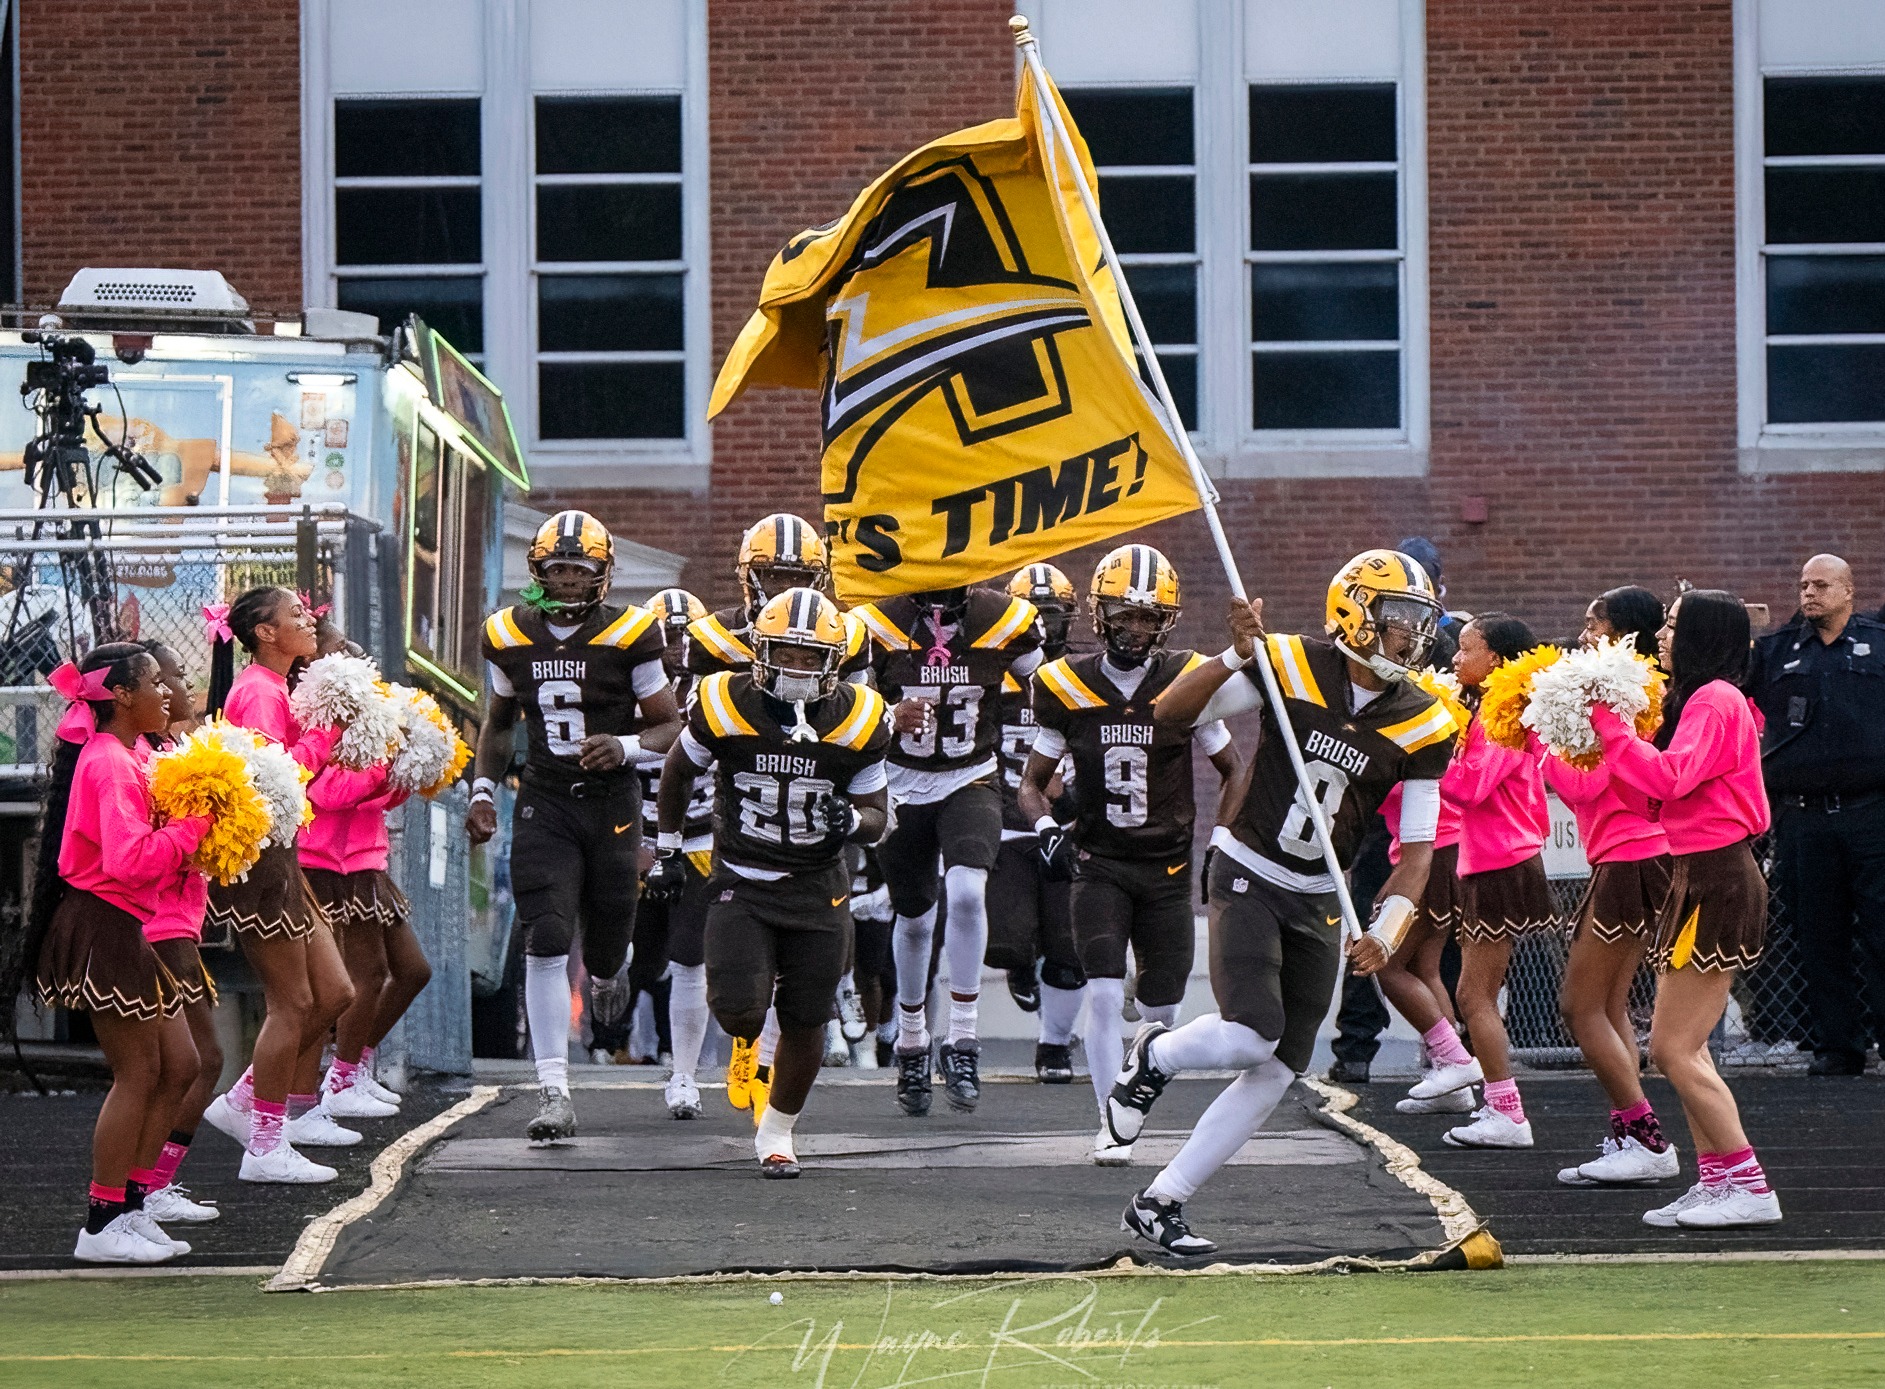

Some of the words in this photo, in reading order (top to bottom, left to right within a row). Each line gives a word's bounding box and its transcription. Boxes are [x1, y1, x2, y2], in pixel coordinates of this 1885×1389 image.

[931, 431, 1149, 560] TIME!
[532, 660, 586, 680] BRUSH
[921, 665, 970, 684] BRUSH
[538, 680, 587, 756] 6
[1100, 724, 1154, 745] BRUSH
[756, 754, 817, 777] BRUSH
[1304, 730, 1370, 776] BRUSH
[733, 771, 836, 845] 20
[1104, 746, 1148, 828] 9
[1277, 760, 1350, 861] 8
